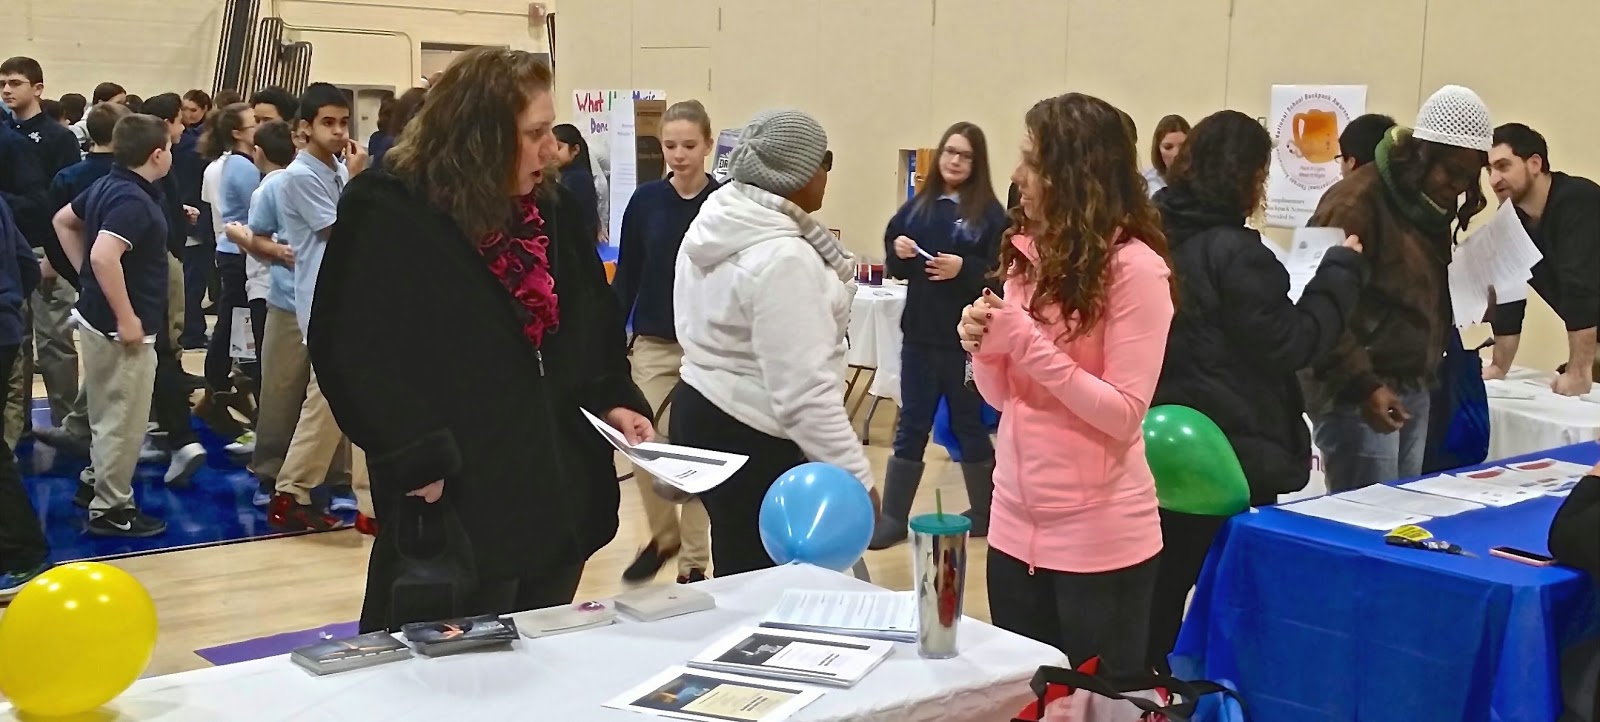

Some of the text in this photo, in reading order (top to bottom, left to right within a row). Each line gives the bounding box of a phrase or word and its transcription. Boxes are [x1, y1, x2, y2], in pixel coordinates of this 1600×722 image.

[575, 91, 604, 113] What
[632, 90, 656, 101] Msic
[590, 117, 608, 134] Done
[1275, 92, 1350, 138] National School Backpack Awarene
